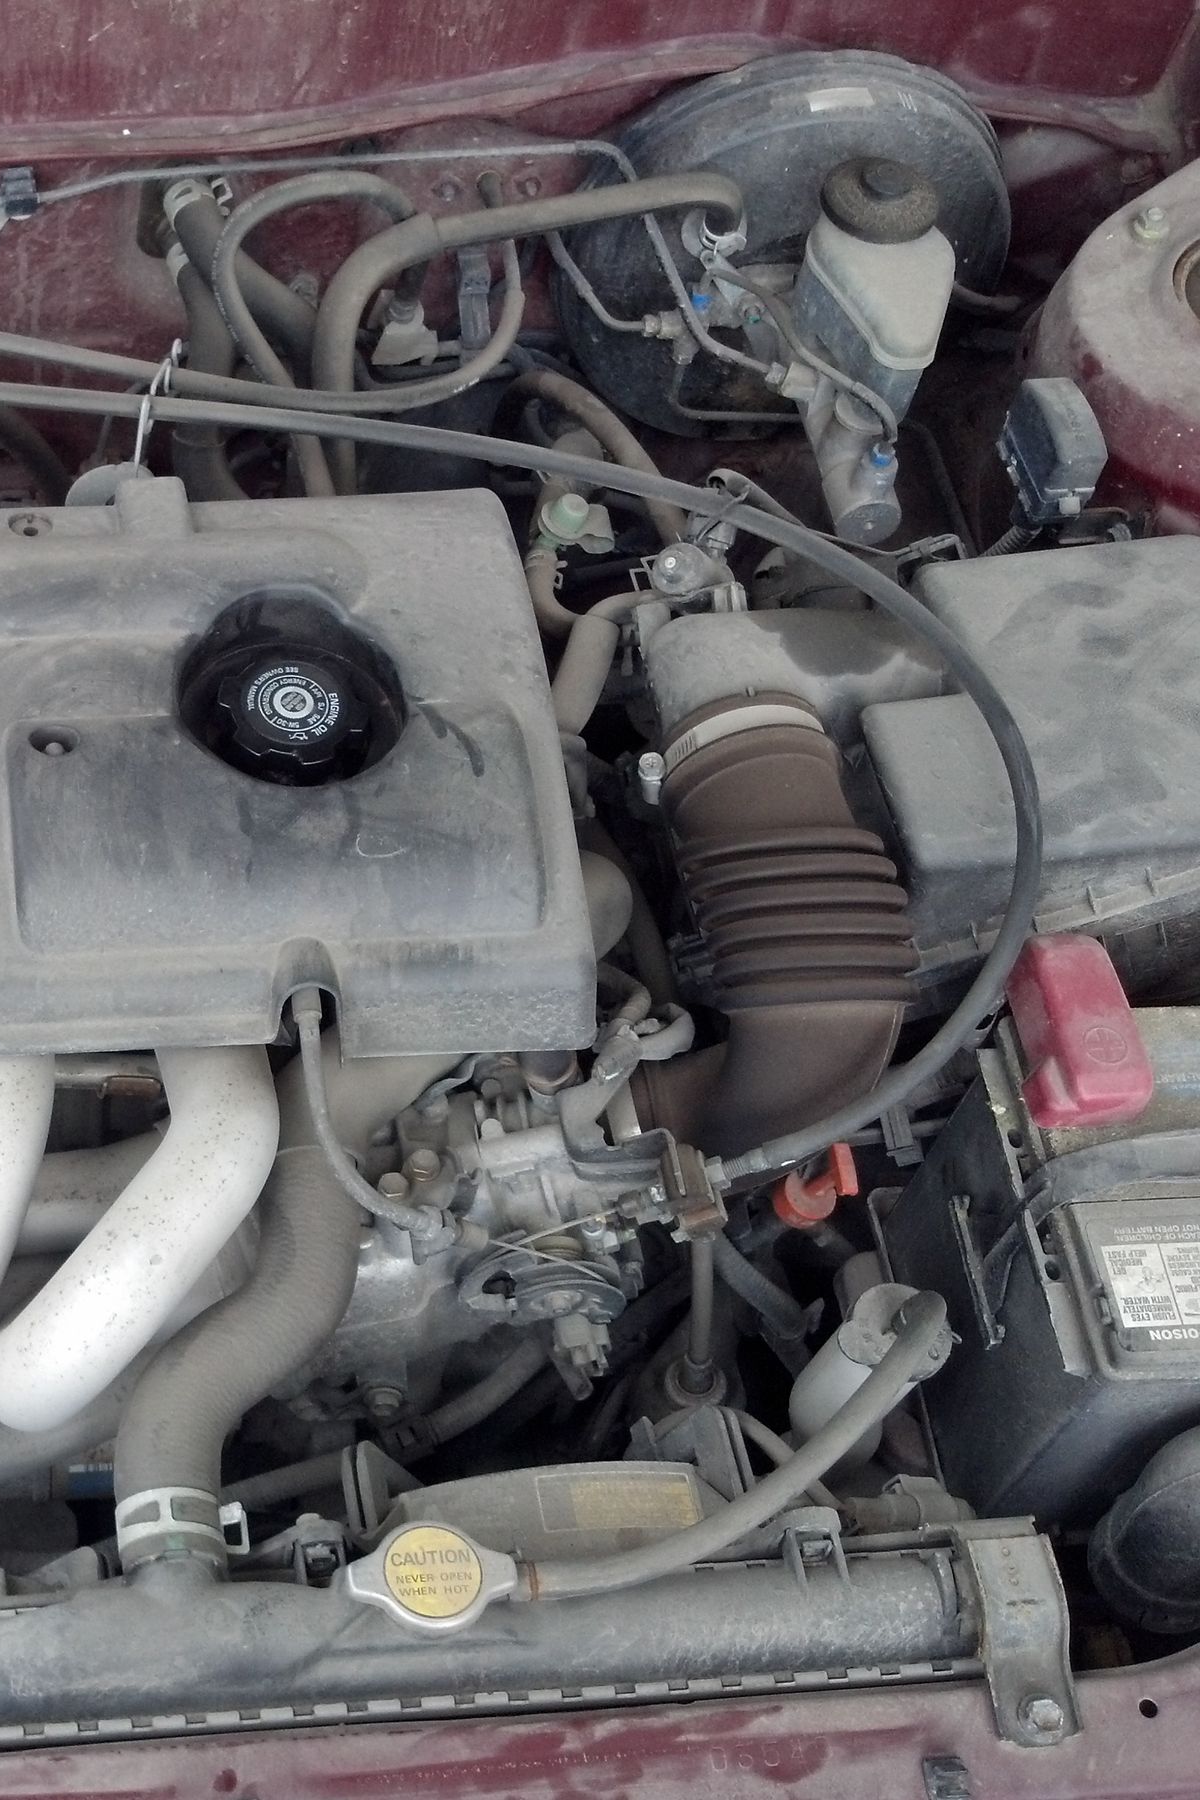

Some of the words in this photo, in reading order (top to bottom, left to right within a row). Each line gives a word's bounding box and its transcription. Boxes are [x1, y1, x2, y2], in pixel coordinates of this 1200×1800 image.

[326, 692, 340, 726] ENGINE
[311, 723, 328, 737] OIL
[1114, 1225, 1152, 1235] BATTERY
[1154, 1224, 1180, 1233] OPEN
[1150, 1295, 1171, 1304] WITH
[1123, 1304, 1173, 1314] IMMEDIATELY
[1130, 1313, 1151, 1322] EYES
[1151, 1312, 1176, 1321] FLUSH
[390, 1548, 471, 1567] CAUTION
[395, 1573, 434, 1585] NEVER
[440, 1571, 473, 1582] OPEN
[399, 1586, 437, 1597] WHEN
[443, 1584, 470, 1595] HOT
